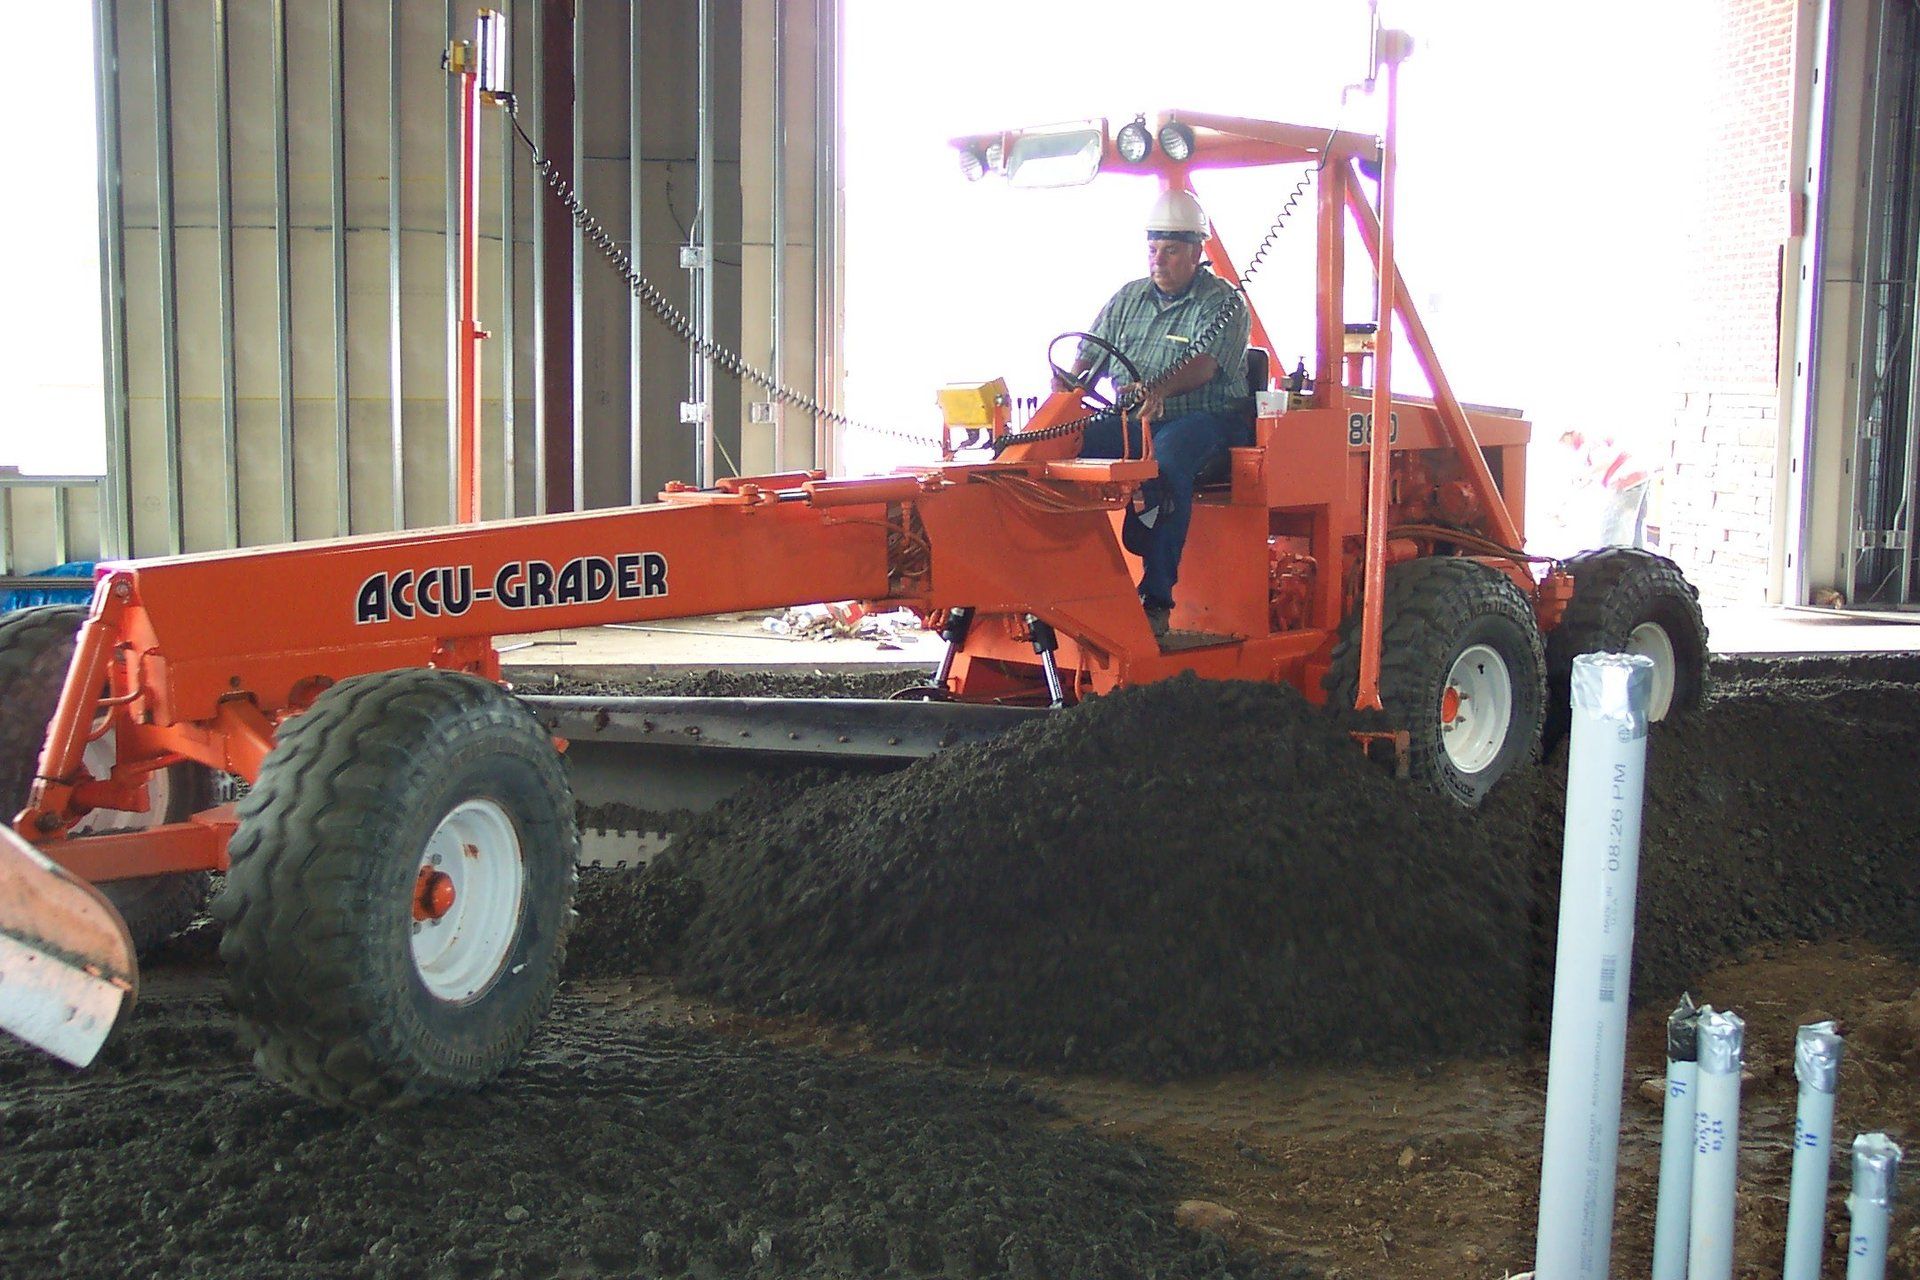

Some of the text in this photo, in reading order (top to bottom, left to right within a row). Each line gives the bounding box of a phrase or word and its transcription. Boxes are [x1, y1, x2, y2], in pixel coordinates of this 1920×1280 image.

[356, 552, 668, 624] ACCU-GRADER
[1607, 763, 1627, 872] 08:26 PM
